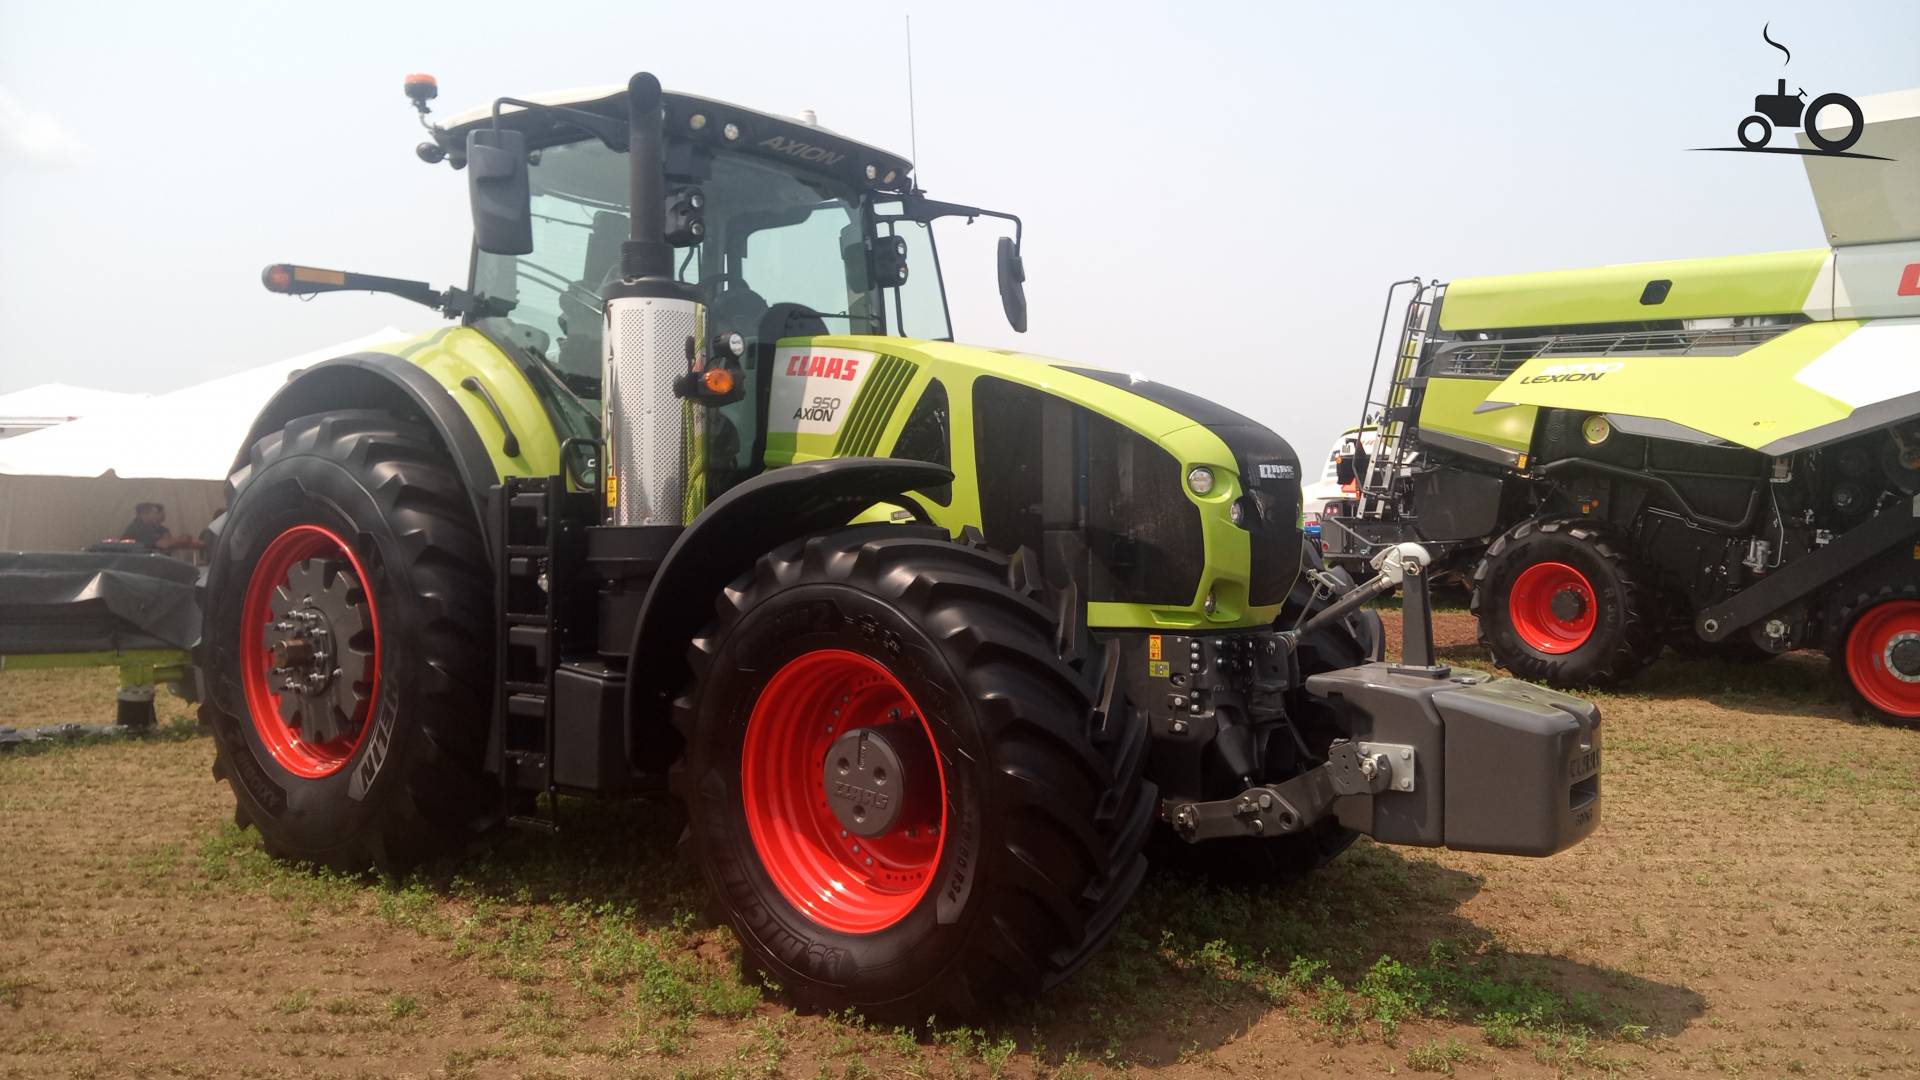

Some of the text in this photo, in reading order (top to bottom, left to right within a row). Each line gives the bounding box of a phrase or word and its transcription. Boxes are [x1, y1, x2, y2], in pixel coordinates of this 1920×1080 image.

[759, 135, 846, 165] AXION
[785, 355, 860, 381] CLAAS
[1520, 372, 1606, 385] LEXION
[812, 396, 841, 410] 950
[793, 407, 835, 422] AXION
